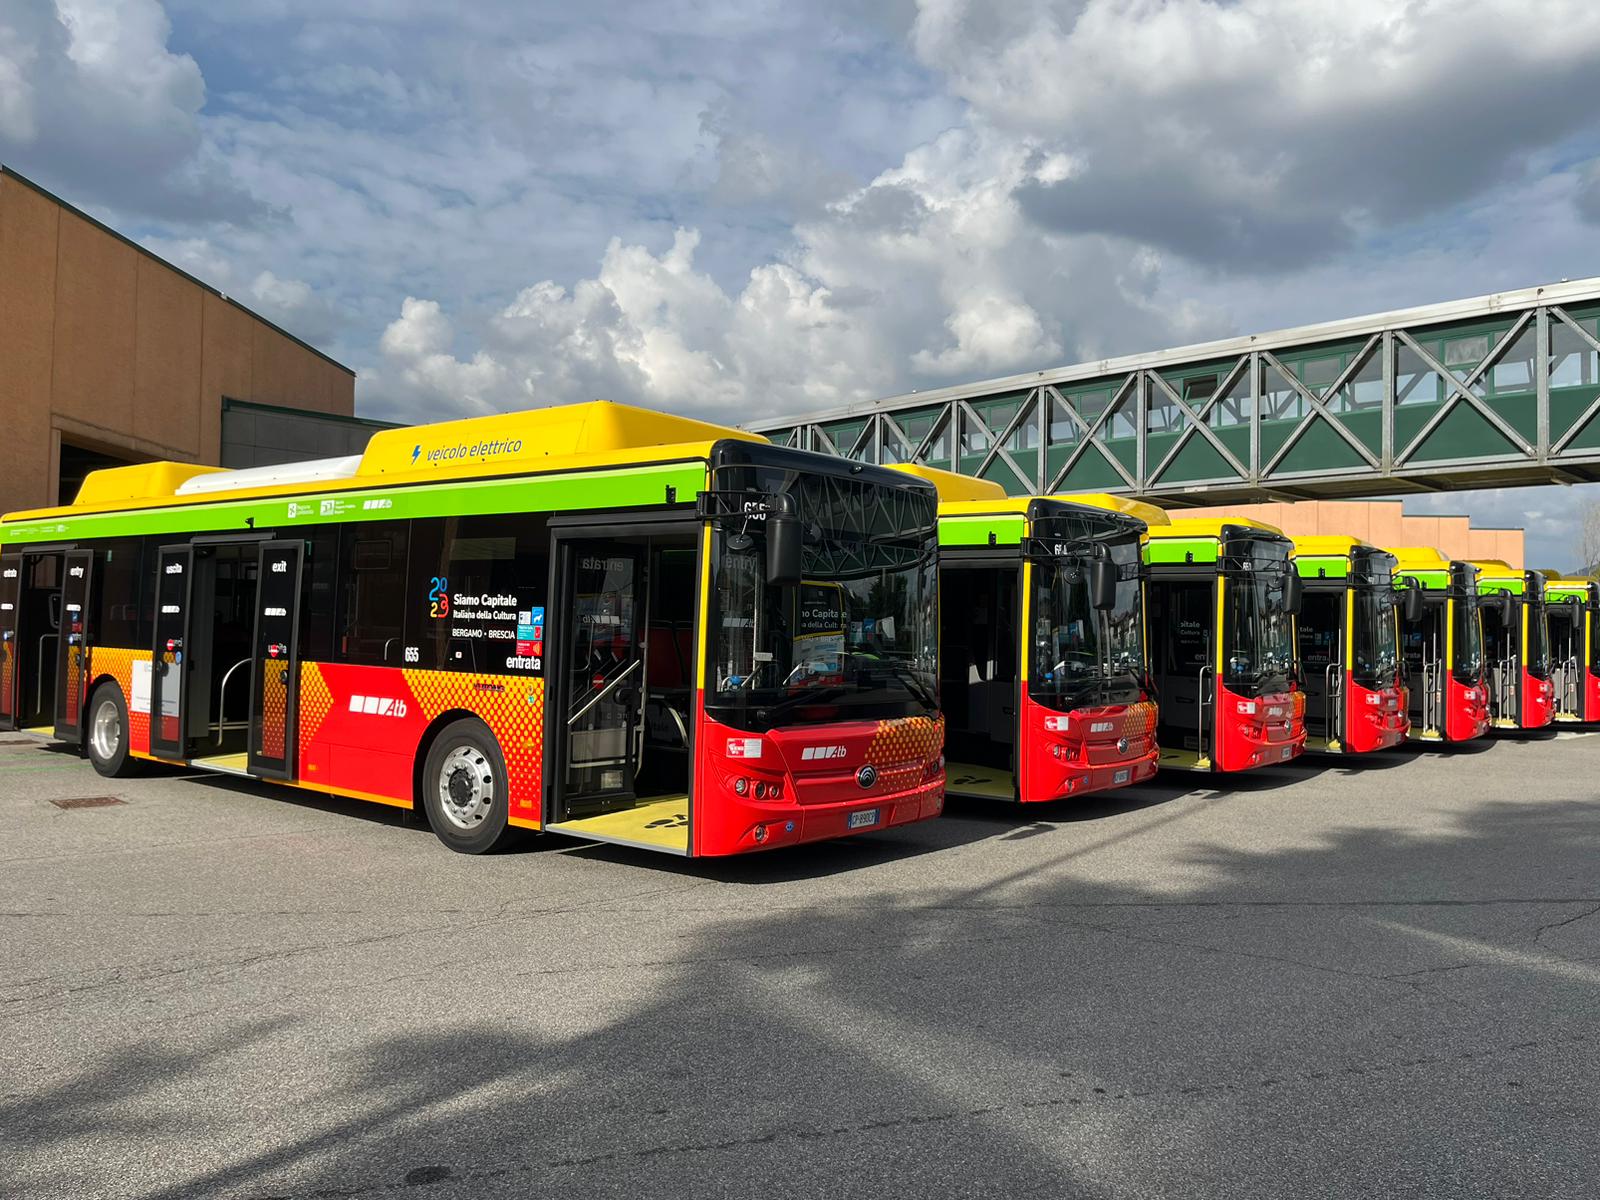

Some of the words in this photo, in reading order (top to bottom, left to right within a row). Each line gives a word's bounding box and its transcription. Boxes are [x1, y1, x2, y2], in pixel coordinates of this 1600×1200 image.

[427, 443, 467, 461] veicolo
[470, 438, 522, 457] elettrico
[272, 560, 287, 573] exit
[453, 593, 479, 606] Siamo
[481, 593, 518, 608] Capitale
[452, 609, 476, 619] Italiana
[476, 610, 492, 620] della
[492, 611, 517, 620] Cultura
[812, 608, 847, 619] Capitae
[452, 628, 482, 638] BERGAMO
[488, 629, 516, 639] BRESCIA
[404, 647, 419, 662] 655
[506, 656, 541, 670] entrata
